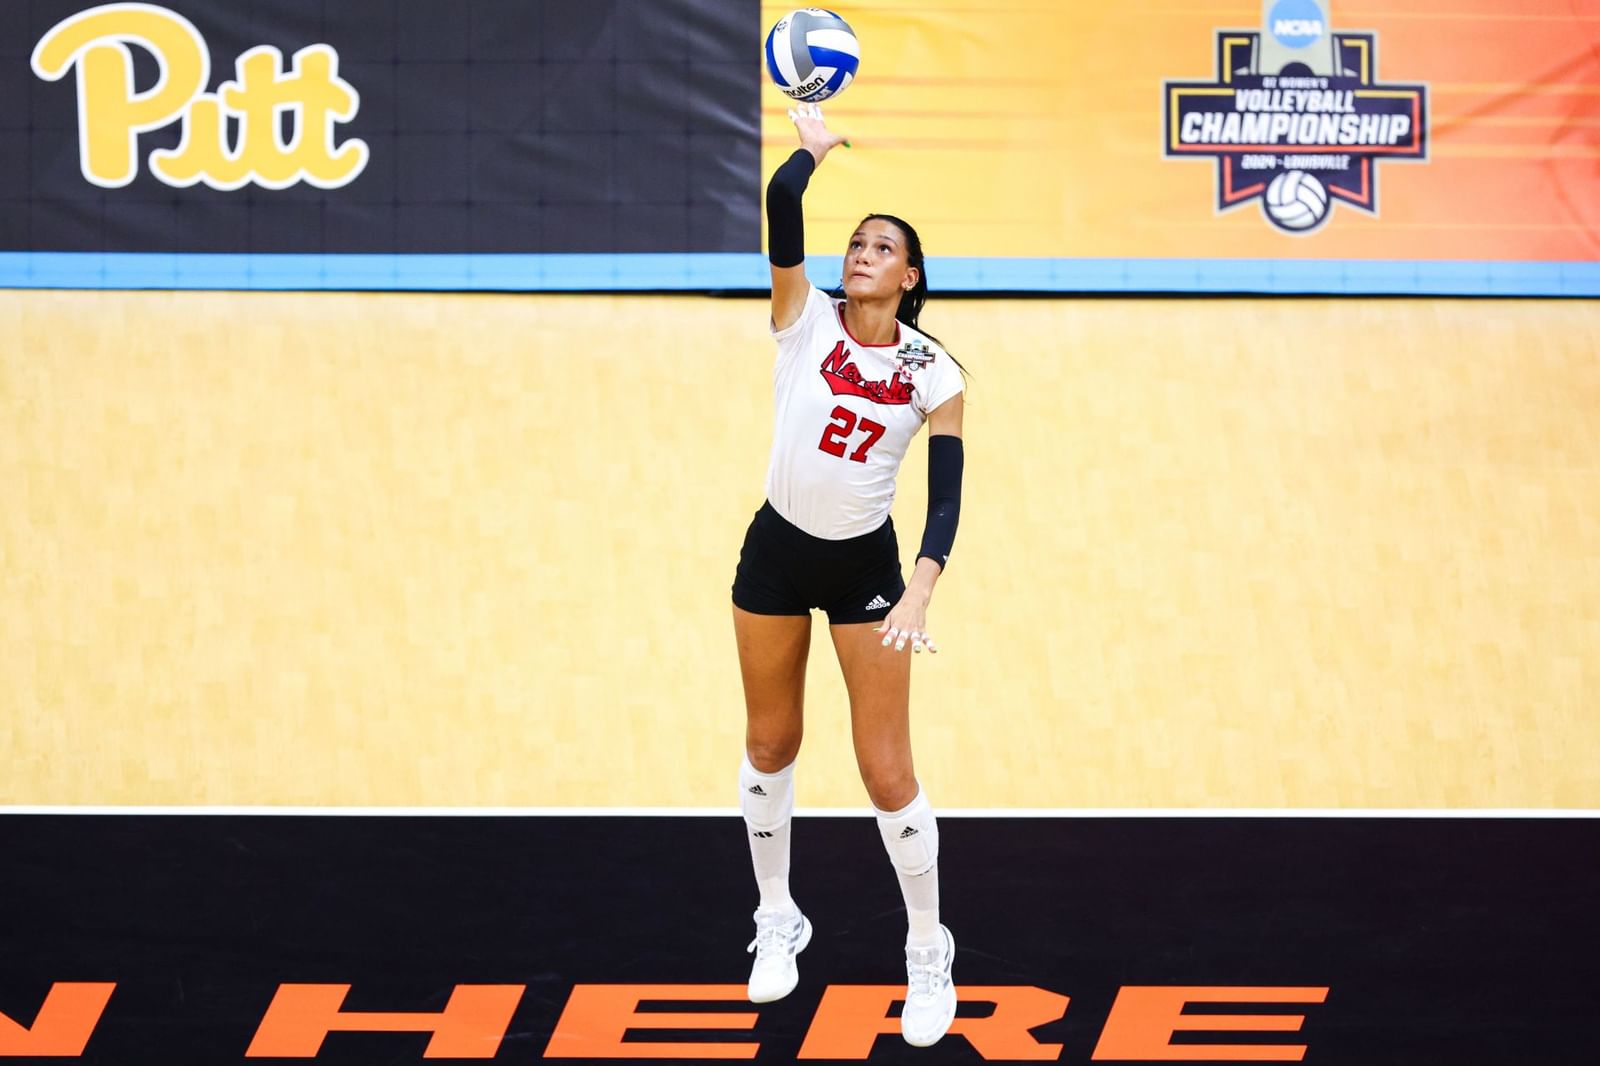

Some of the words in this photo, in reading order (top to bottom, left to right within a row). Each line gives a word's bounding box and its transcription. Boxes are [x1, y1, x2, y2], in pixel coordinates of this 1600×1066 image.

[1275, 19, 1322, 37] NCAA
[30, 2, 370, 191] Pitt
[1235, 89, 1356, 114] VOLLEYBALL
[1181, 112, 1411, 146] CHAMPIONSHIP
[1241, 154, 1277, 170] 2024
[1283, 154, 1351, 170] LOUISVILLE
[818, 405, 887, 465] 27
[244, 984, 1330, 1061] HERE
